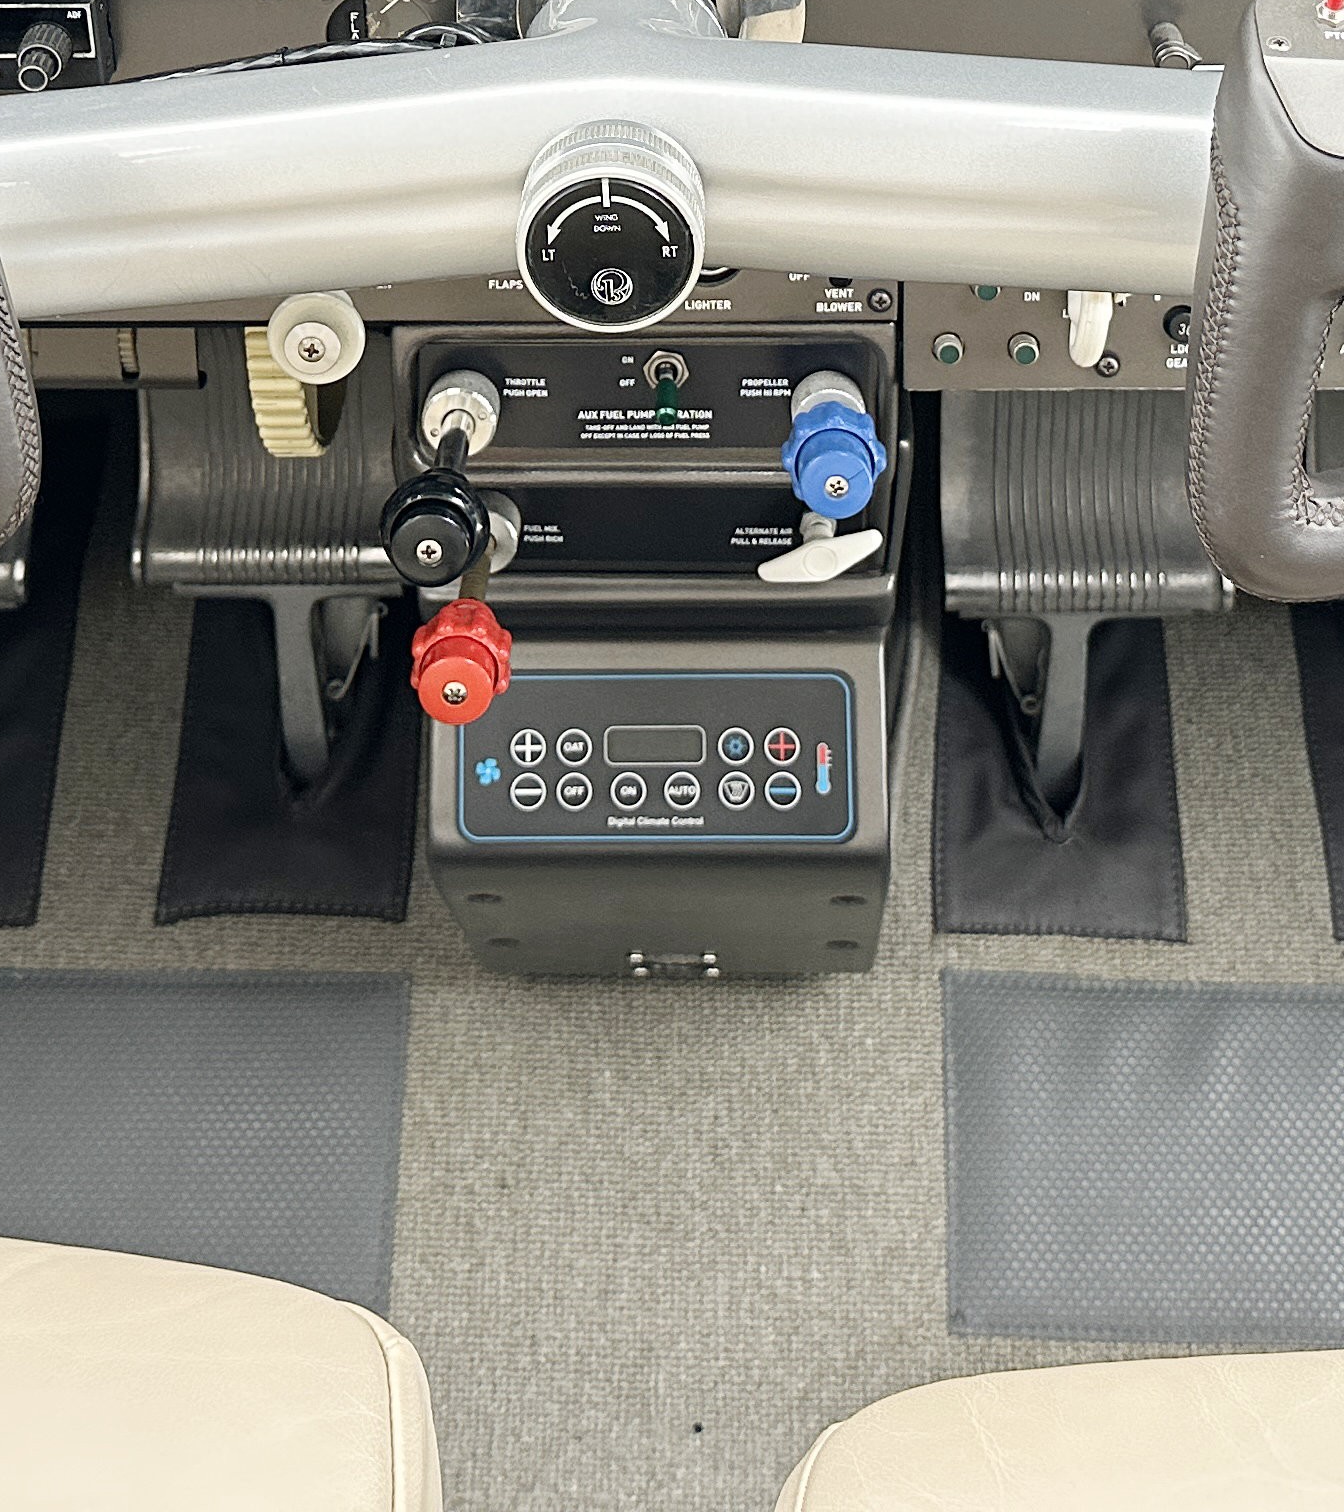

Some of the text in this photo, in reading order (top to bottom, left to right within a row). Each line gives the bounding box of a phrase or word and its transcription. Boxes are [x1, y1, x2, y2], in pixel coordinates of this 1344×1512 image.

[542, 249, 556, 261] LT
[662, 246, 678, 259] RT
[488, 280, 523, 290] FLAPS
[825, 289, 853, 299] VENT
[685, 300, 731, 310] LIGHTER
[816, 302, 862, 312] BLOWER
[578, 411, 598, 419] AUX
[600, 411, 625, 419] FUEL
[627, 411, 655, 419] PUMP
[564, 785, 585, 797] OFF
[620, 785, 637, 797] ON
[669, 784, 696, 796] AUTO
[607, 816, 704, 828] Digital Climate Control
